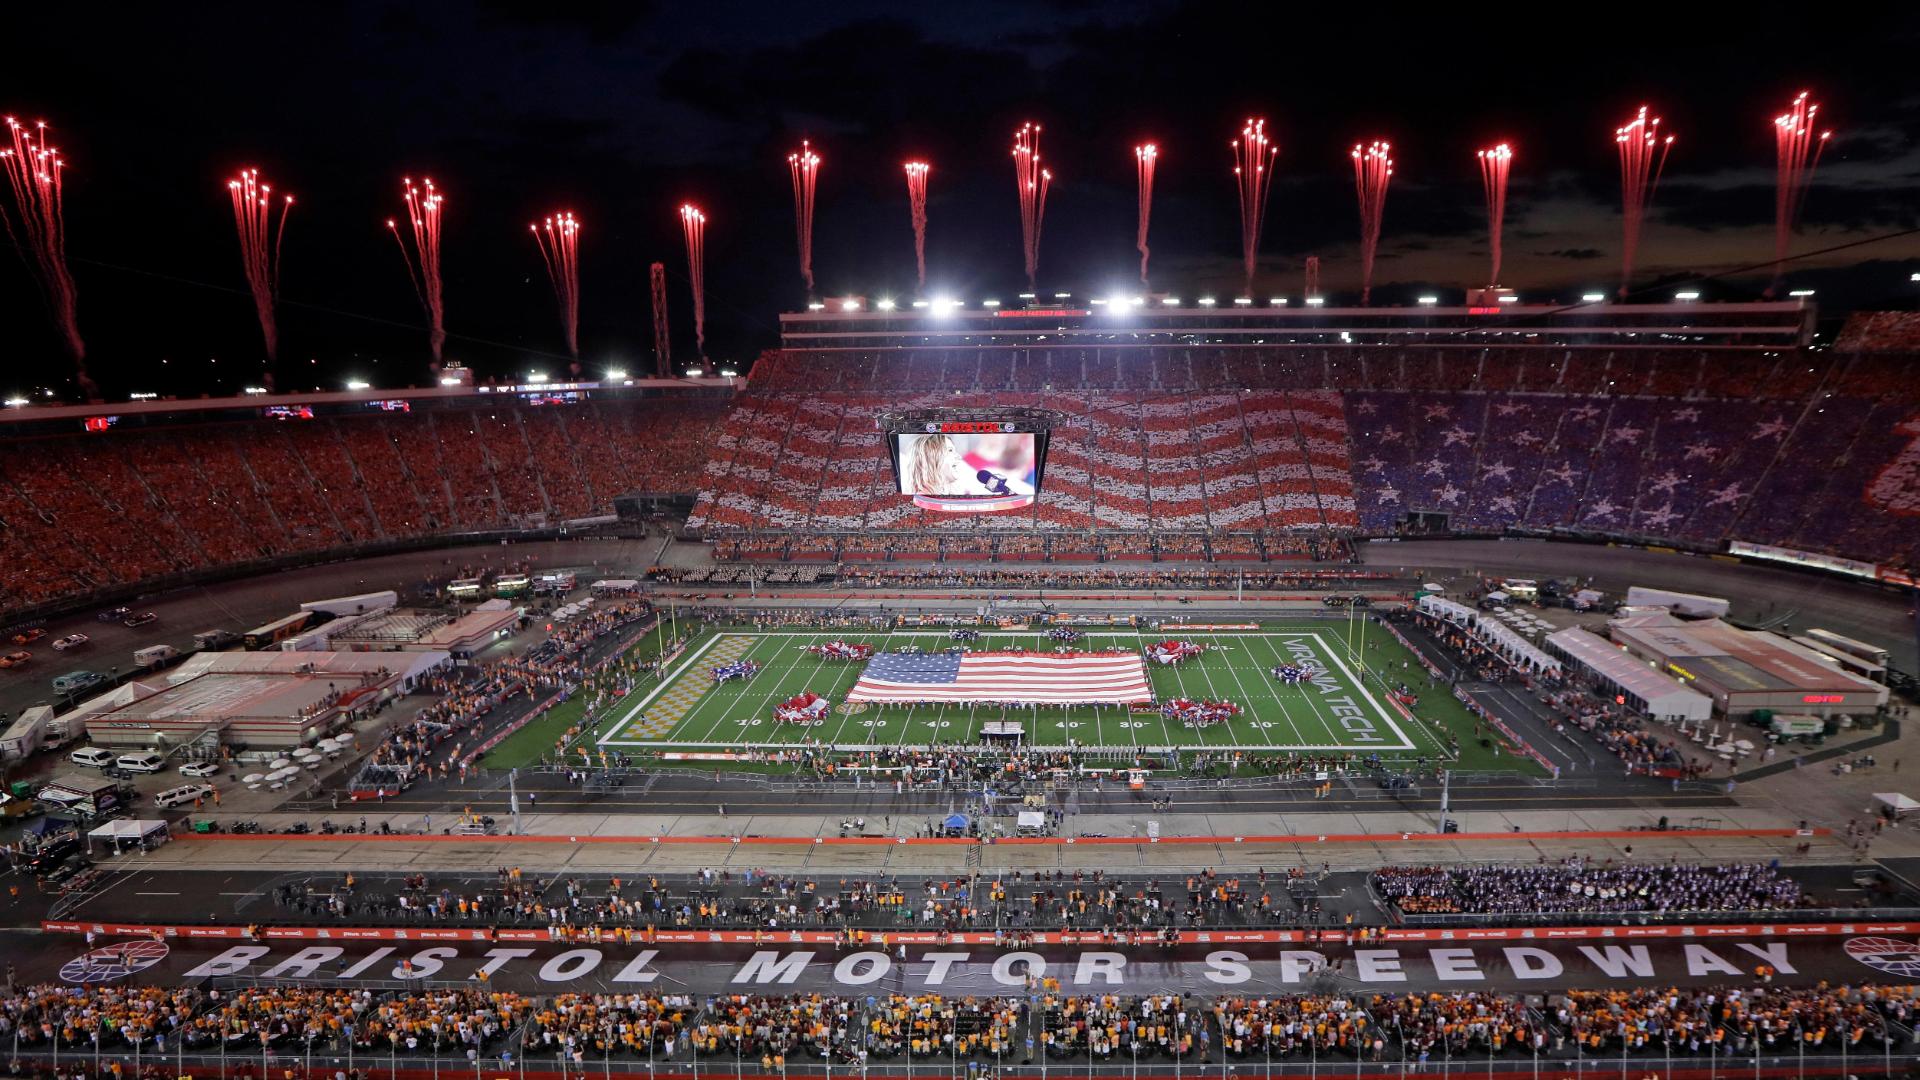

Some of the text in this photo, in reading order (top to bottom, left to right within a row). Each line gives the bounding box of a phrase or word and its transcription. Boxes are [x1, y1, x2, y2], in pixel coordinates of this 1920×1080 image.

[926, 720, 950, 728] 40
[1325, 696, 1384, 741] TECH
[182, 942, 1799, 986] BRISTOL MOTOR SPEEDWAY
